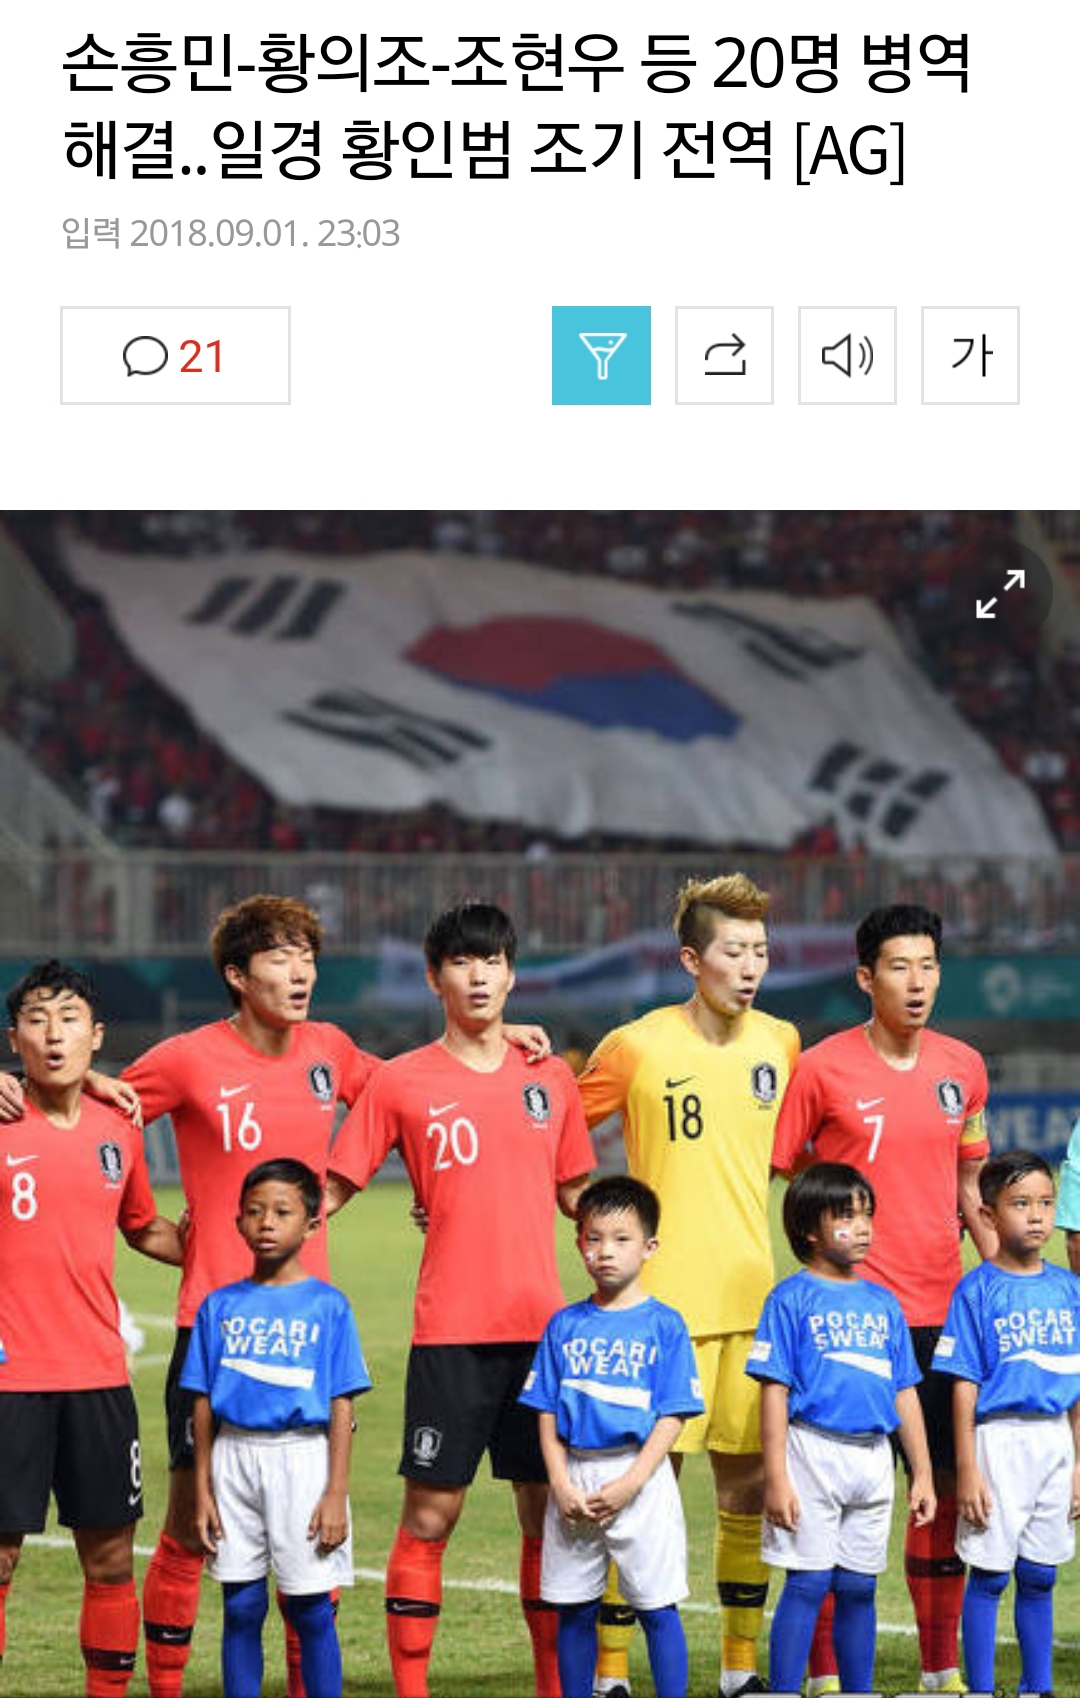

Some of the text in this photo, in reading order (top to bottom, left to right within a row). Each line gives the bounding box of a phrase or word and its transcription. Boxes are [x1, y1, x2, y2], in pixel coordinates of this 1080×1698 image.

[63, 33, 968, 93] 손흥민-황의조-조현우 등 20명 병역
[65, 120, 903, 185] 해결..일경 황인범 조기 전역 [AG]
[63, 218, 399, 249] 입력 2018.09.01. 23:03
[180, 340, 223, 372] 21
[952, 334, 993, 377] 가
[217, 1103, 261, 1151] 16
[664, 1095, 703, 1141] 18
[863, 1115, 884, 1162] 7
[426, 1118, 478, 1171] 20
[11, 1173, 38, 1220] 8
[222, 1316, 320, 1344] OCARI
